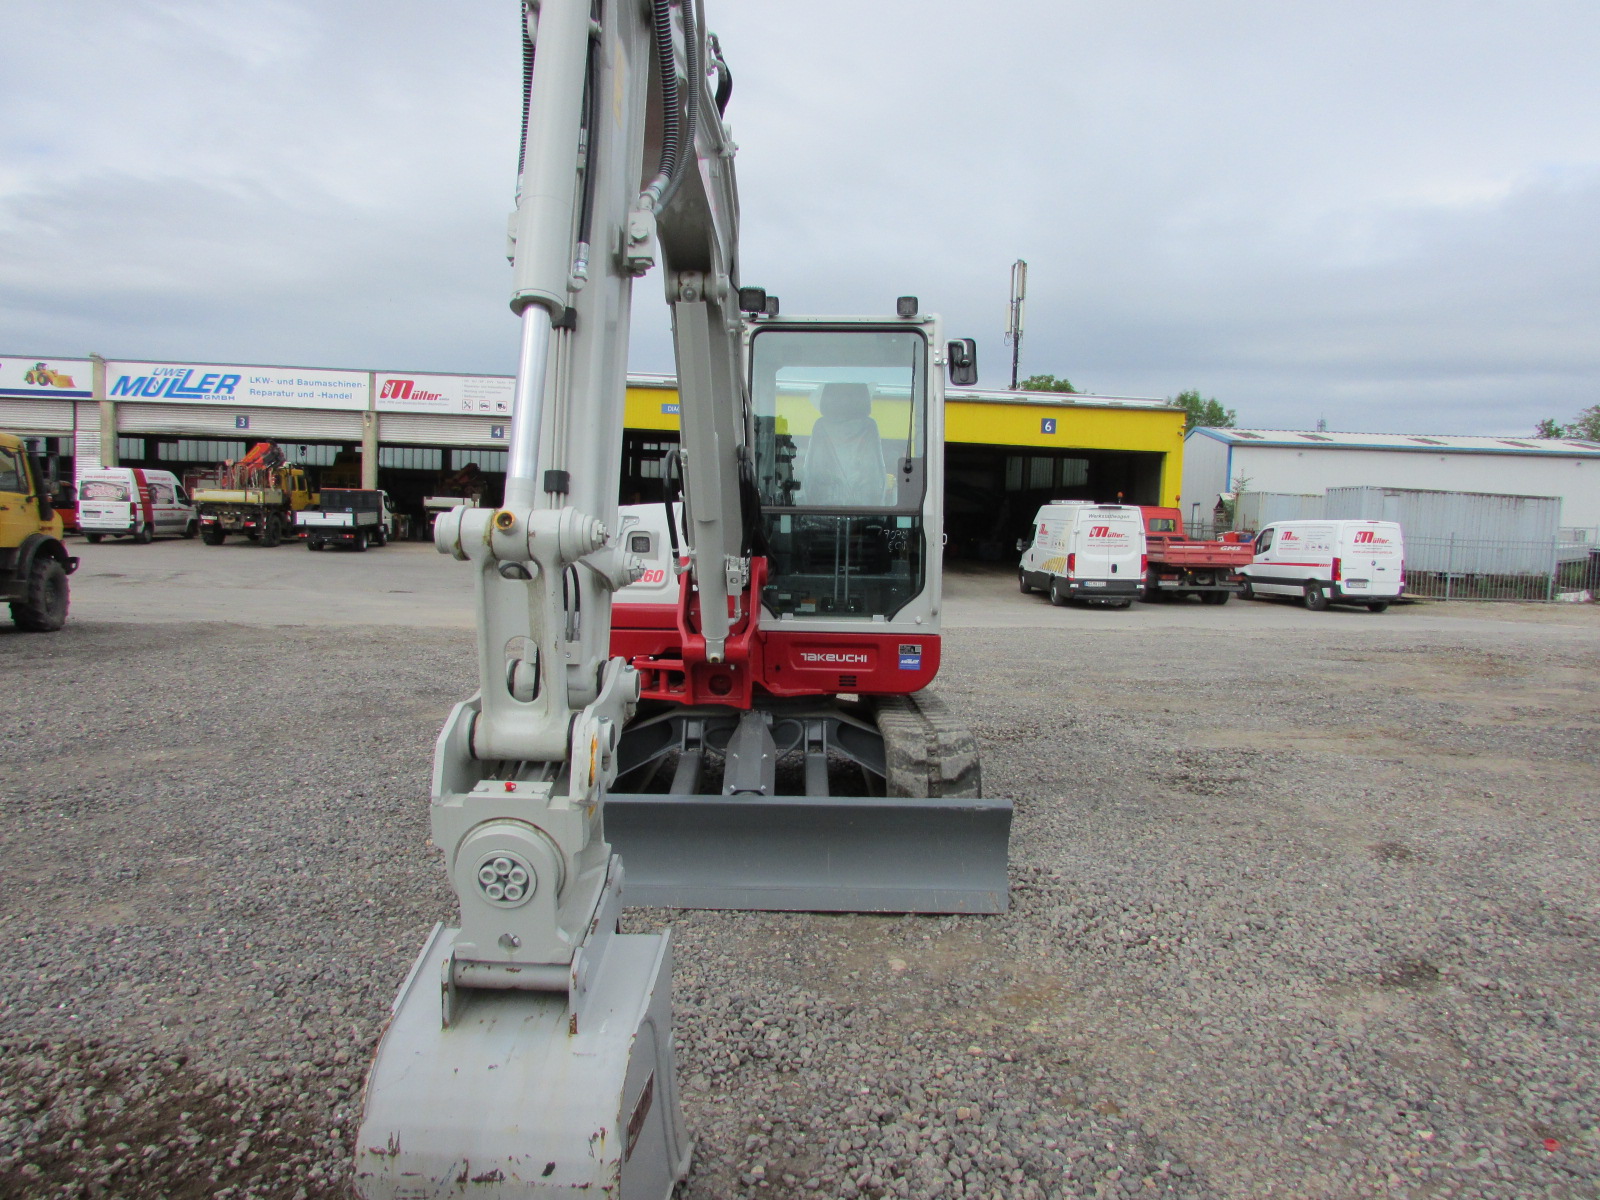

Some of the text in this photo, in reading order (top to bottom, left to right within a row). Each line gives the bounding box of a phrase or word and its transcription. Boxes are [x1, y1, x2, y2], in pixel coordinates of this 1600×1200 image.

[153, 368, 186, 377] UWE
[110, 369, 242, 399] MÜLLER
[250, 376, 273, 384] LKW-
[297, 379, 366, 389] Baumaschinen-
[250, 388, 353, 400] Reparatur und -Handel
[1045, 421, 1052, 432] 6
[800, 653, 867, 663] TAKEUCHI
